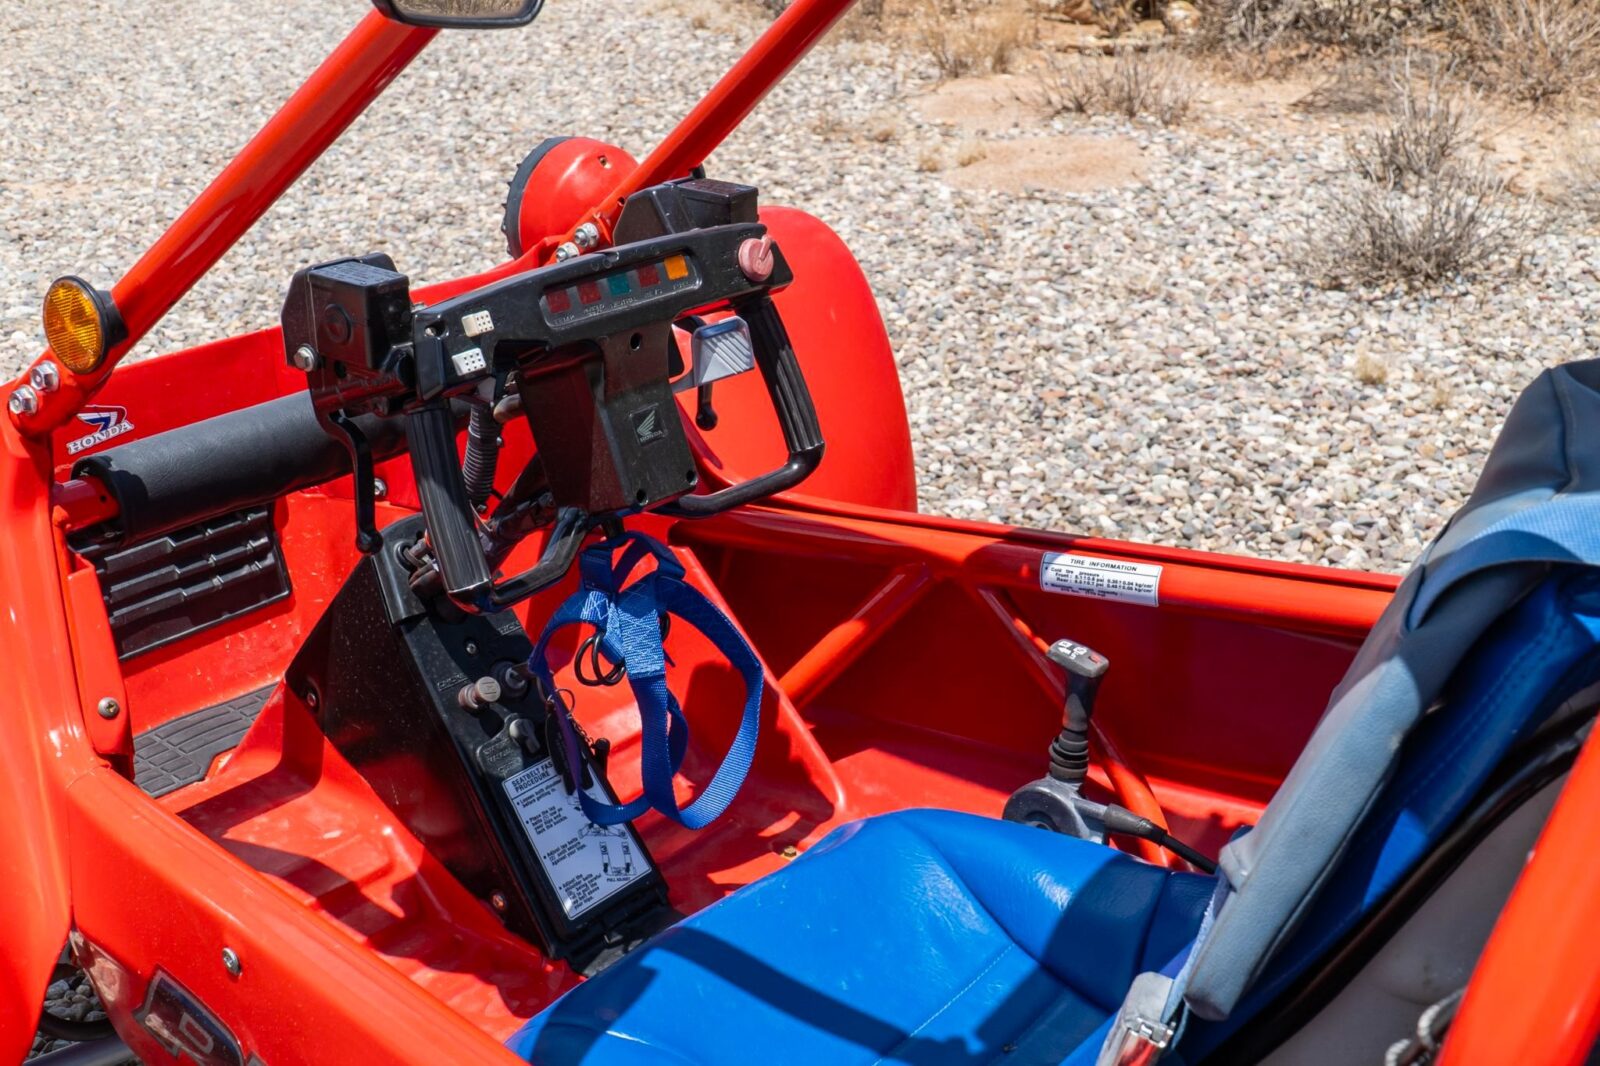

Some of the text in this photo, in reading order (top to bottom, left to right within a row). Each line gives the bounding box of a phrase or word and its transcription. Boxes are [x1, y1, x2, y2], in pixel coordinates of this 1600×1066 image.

[66, 420, 134, 454] HONDA
[1089, 562, 1138, 571] INFORMATION
[512, 768, 540, 787] SEATBELT
[515, 770, 550, 792] PROCEDURE
